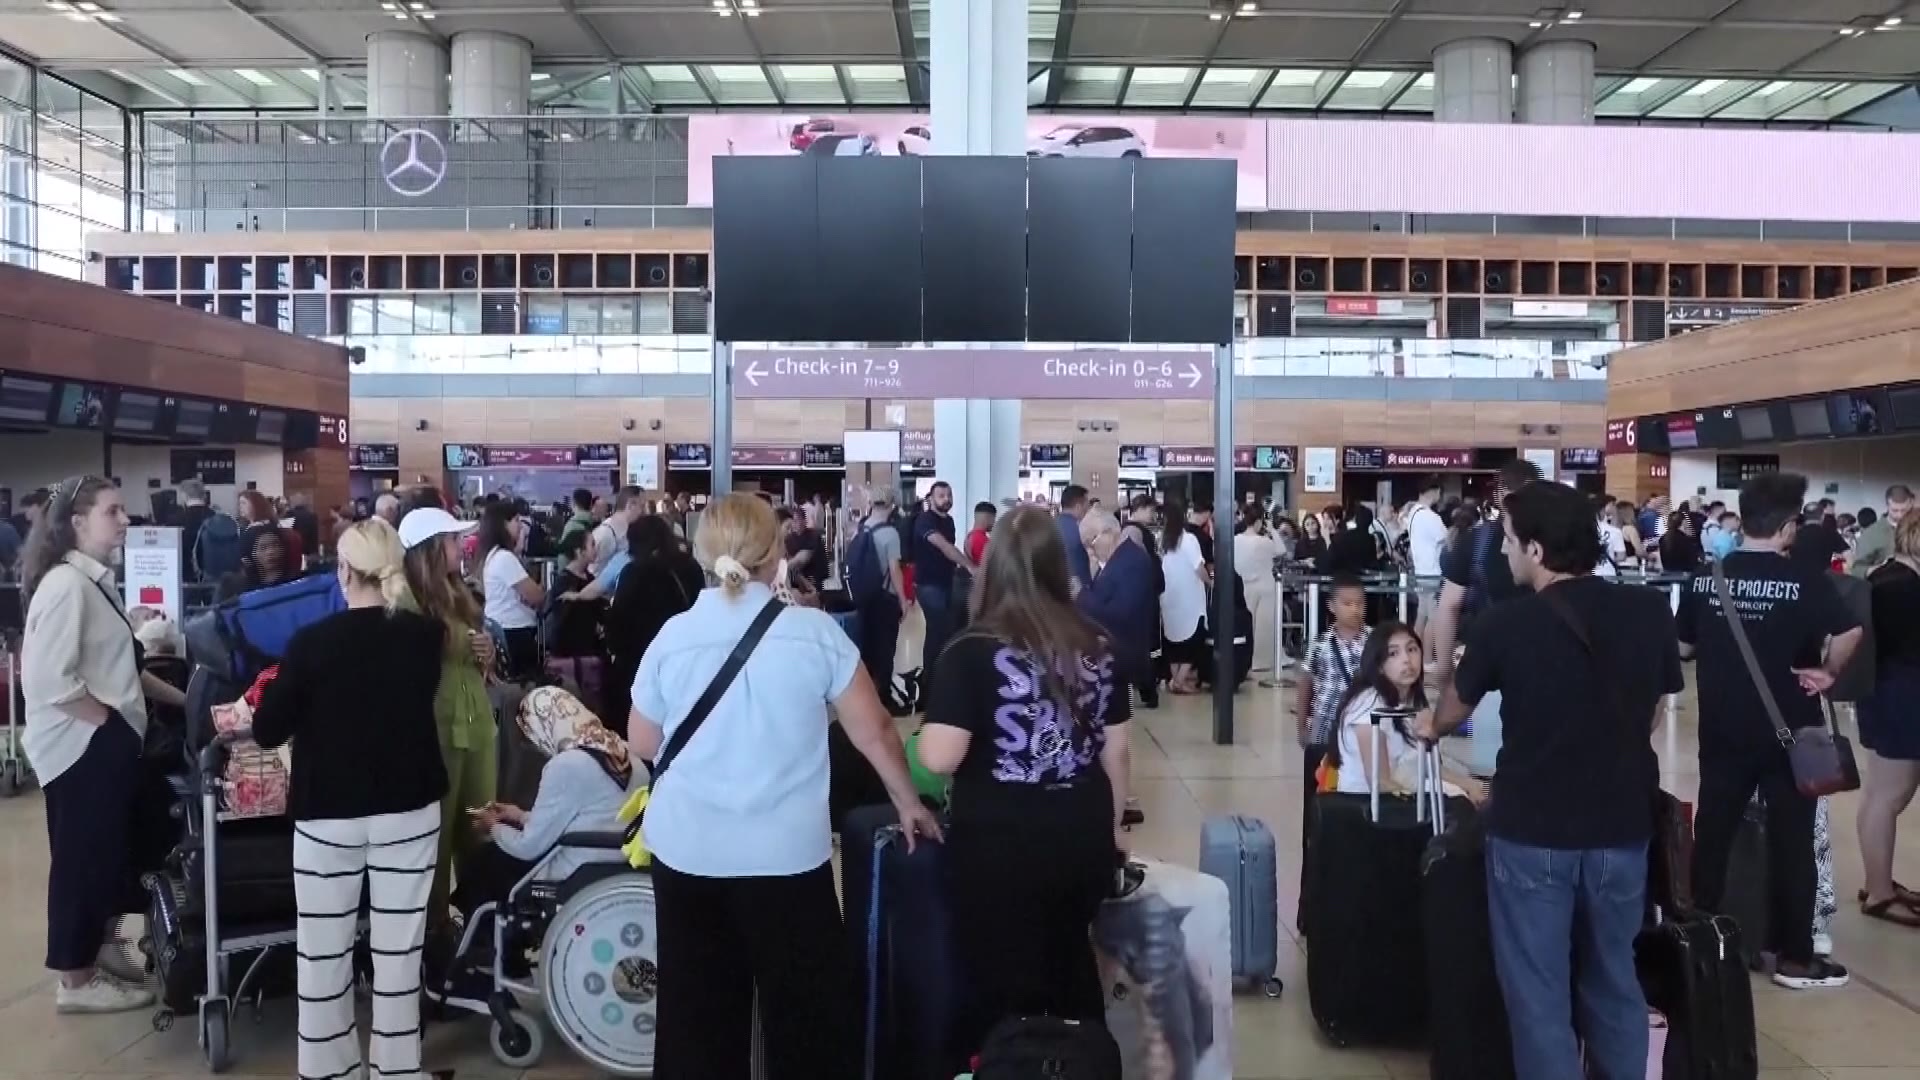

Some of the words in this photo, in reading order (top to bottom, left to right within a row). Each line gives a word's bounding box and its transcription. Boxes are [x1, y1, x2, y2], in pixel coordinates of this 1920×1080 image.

[774, 356, 857, 375] Check-in
[863, 358, 899, 376] 7–9
[1043, 358, 1126, 377] Check-in
[1133, 359, 1172, 377] 0–6
[338, 419, 347, 444] 8
[1626, 420, 1635, 447] 6
[1398, 455, 1414, 464] BER
[1415, 455, 1449, 467] Runway
[1737, 580, 1800, 601] PROJECTS
